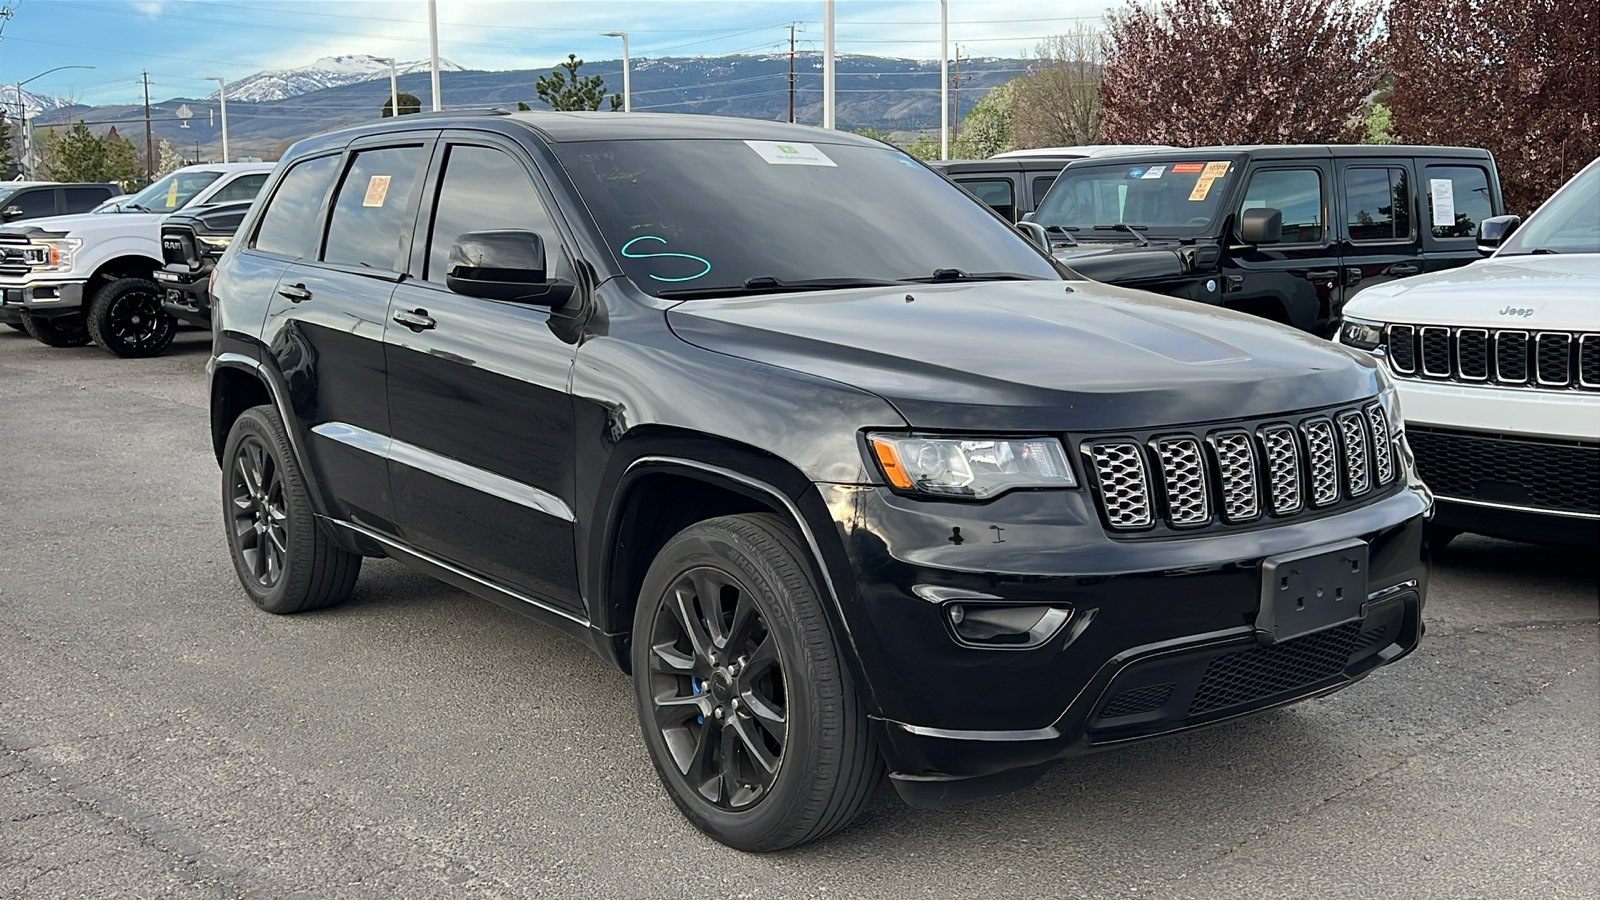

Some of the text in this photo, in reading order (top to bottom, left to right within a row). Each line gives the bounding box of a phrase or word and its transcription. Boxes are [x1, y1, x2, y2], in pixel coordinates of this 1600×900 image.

[164, 241, 181, 250] RAM
[621, 235, 712, 282] S
[1499, 305, 1534, 318] Jeep
[734, 555, 788, 629] Hankook
